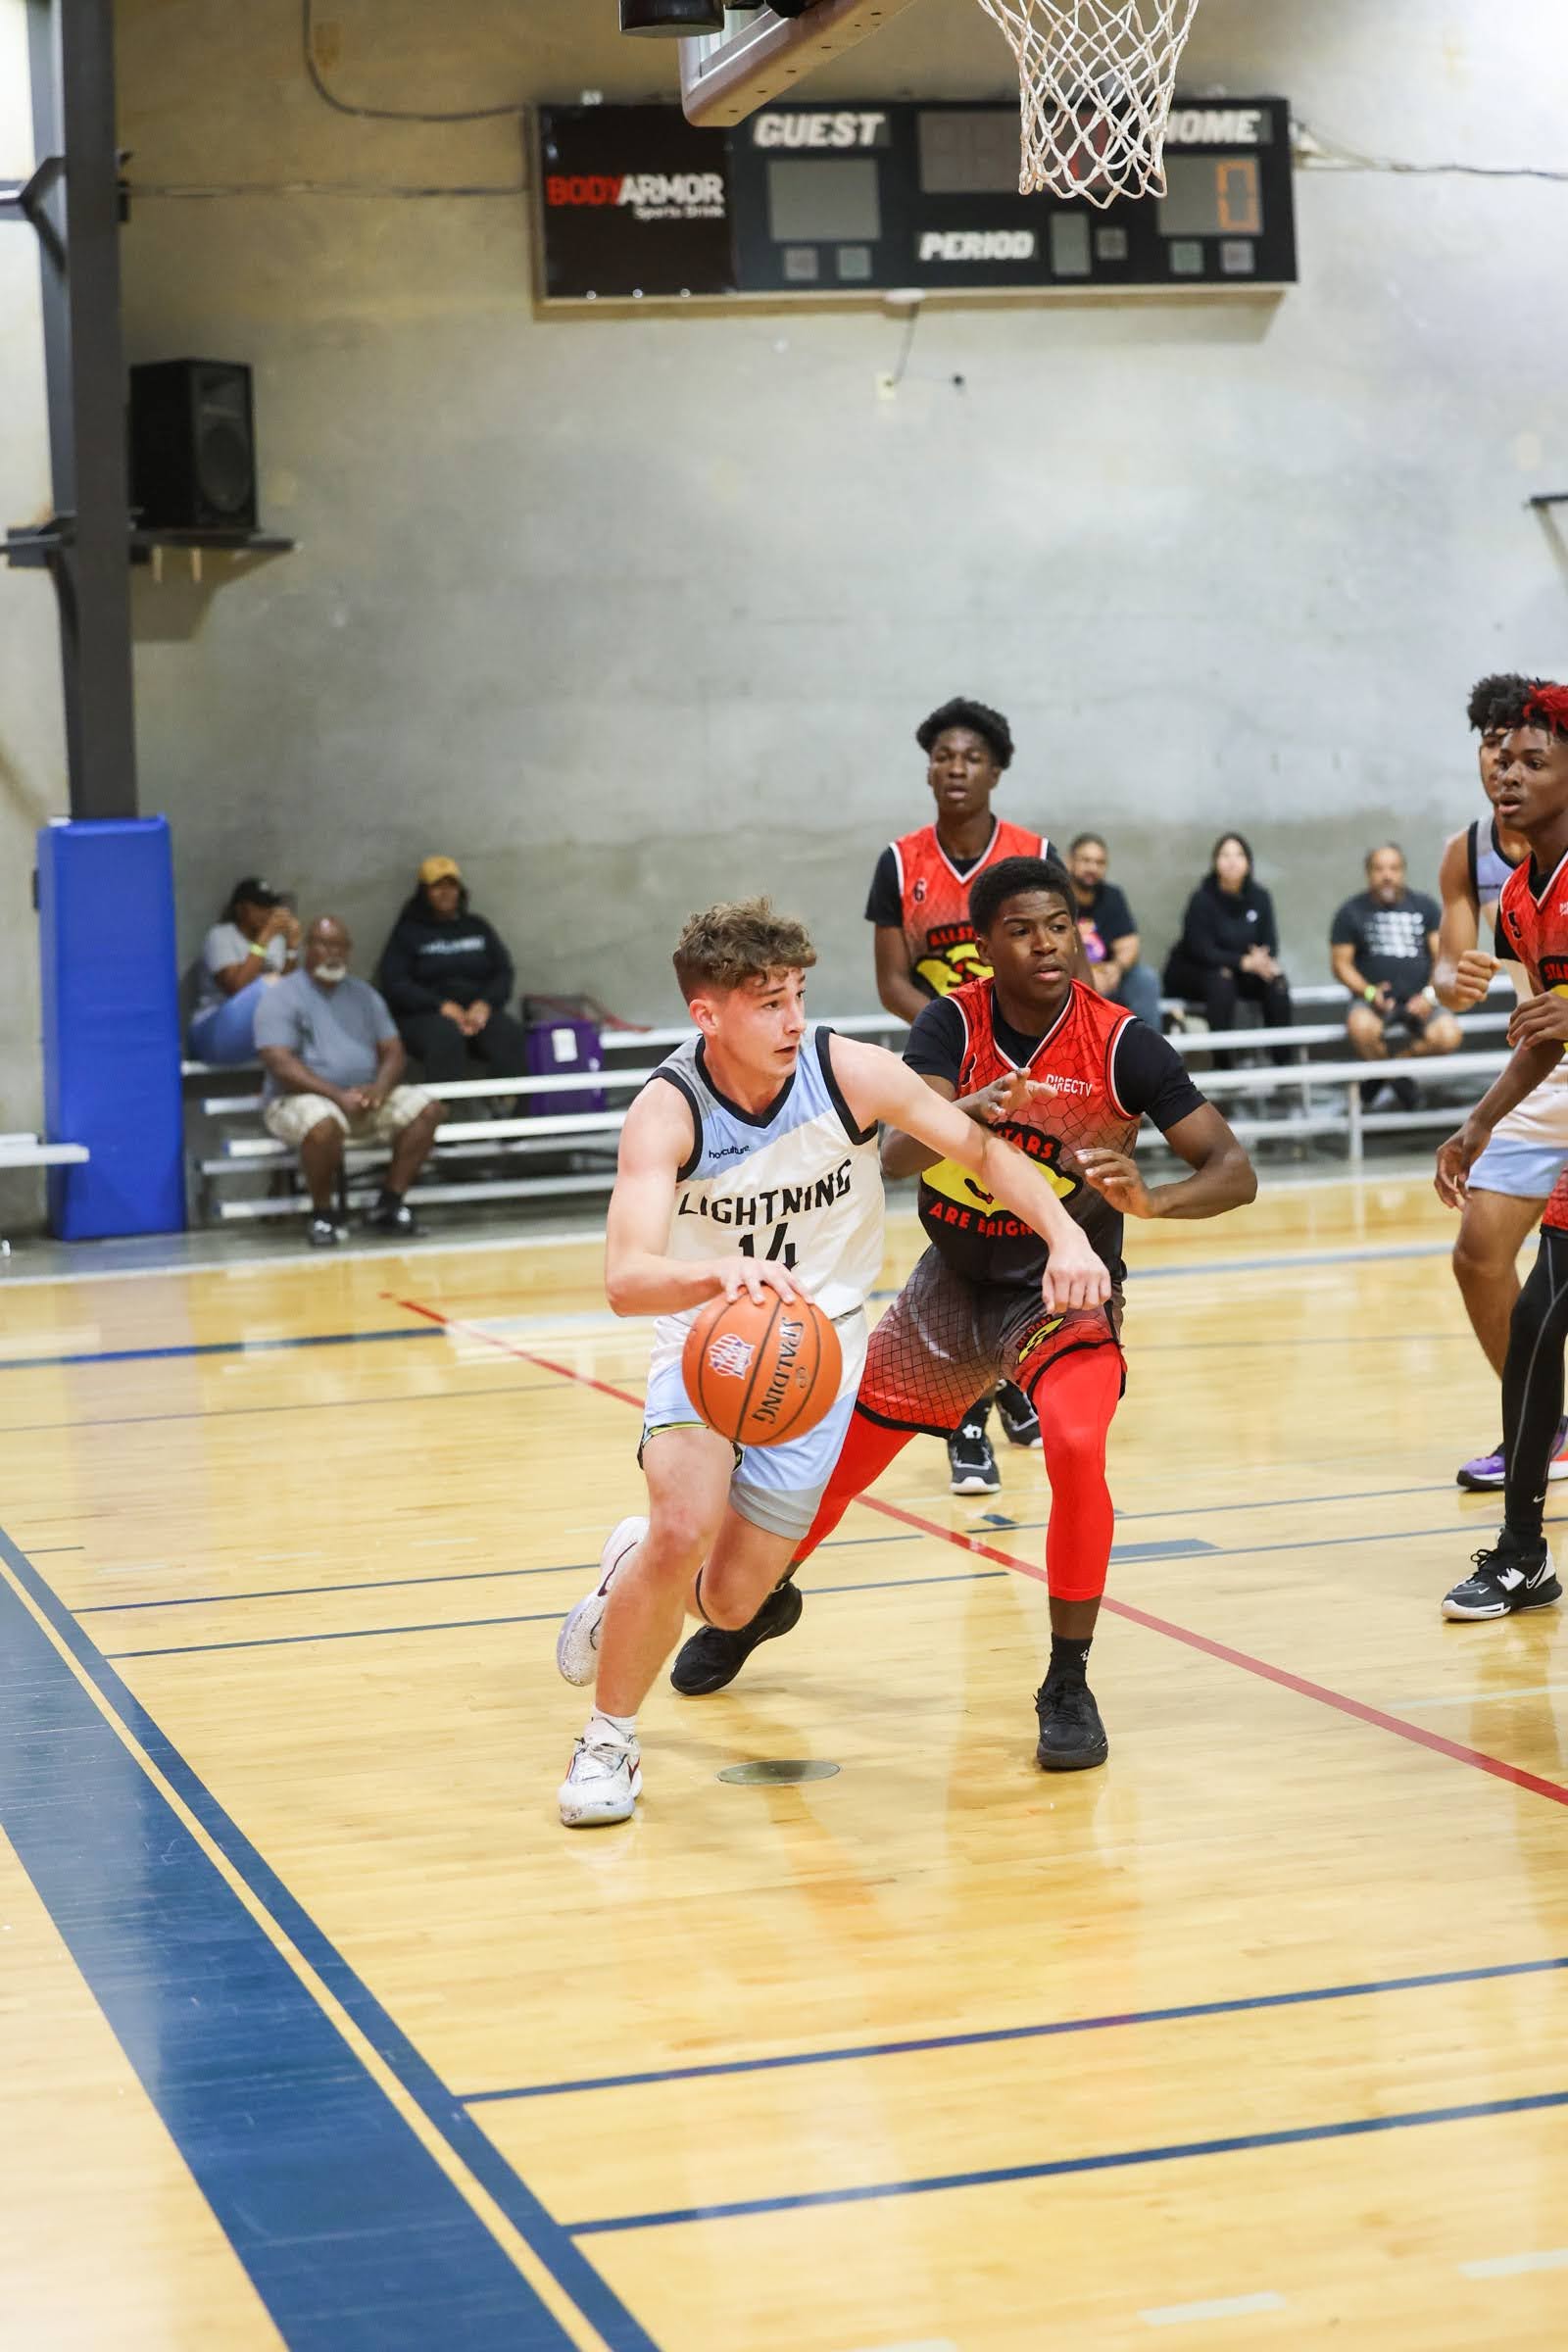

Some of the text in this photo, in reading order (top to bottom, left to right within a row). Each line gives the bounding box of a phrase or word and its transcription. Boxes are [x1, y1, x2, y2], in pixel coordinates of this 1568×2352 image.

[753, 112, 886, 148] GUEST
[547, 172, 725, 207] BODYARMOR
[918, 230, 1035, 262] PERIOD
[912, 877, 927, 904] 6
[678, 1158, 853, 1226] LIGHTNING
[928, 1201, 971, 1230] ARE
[751, 1316, 804, 1425] SPALDING
